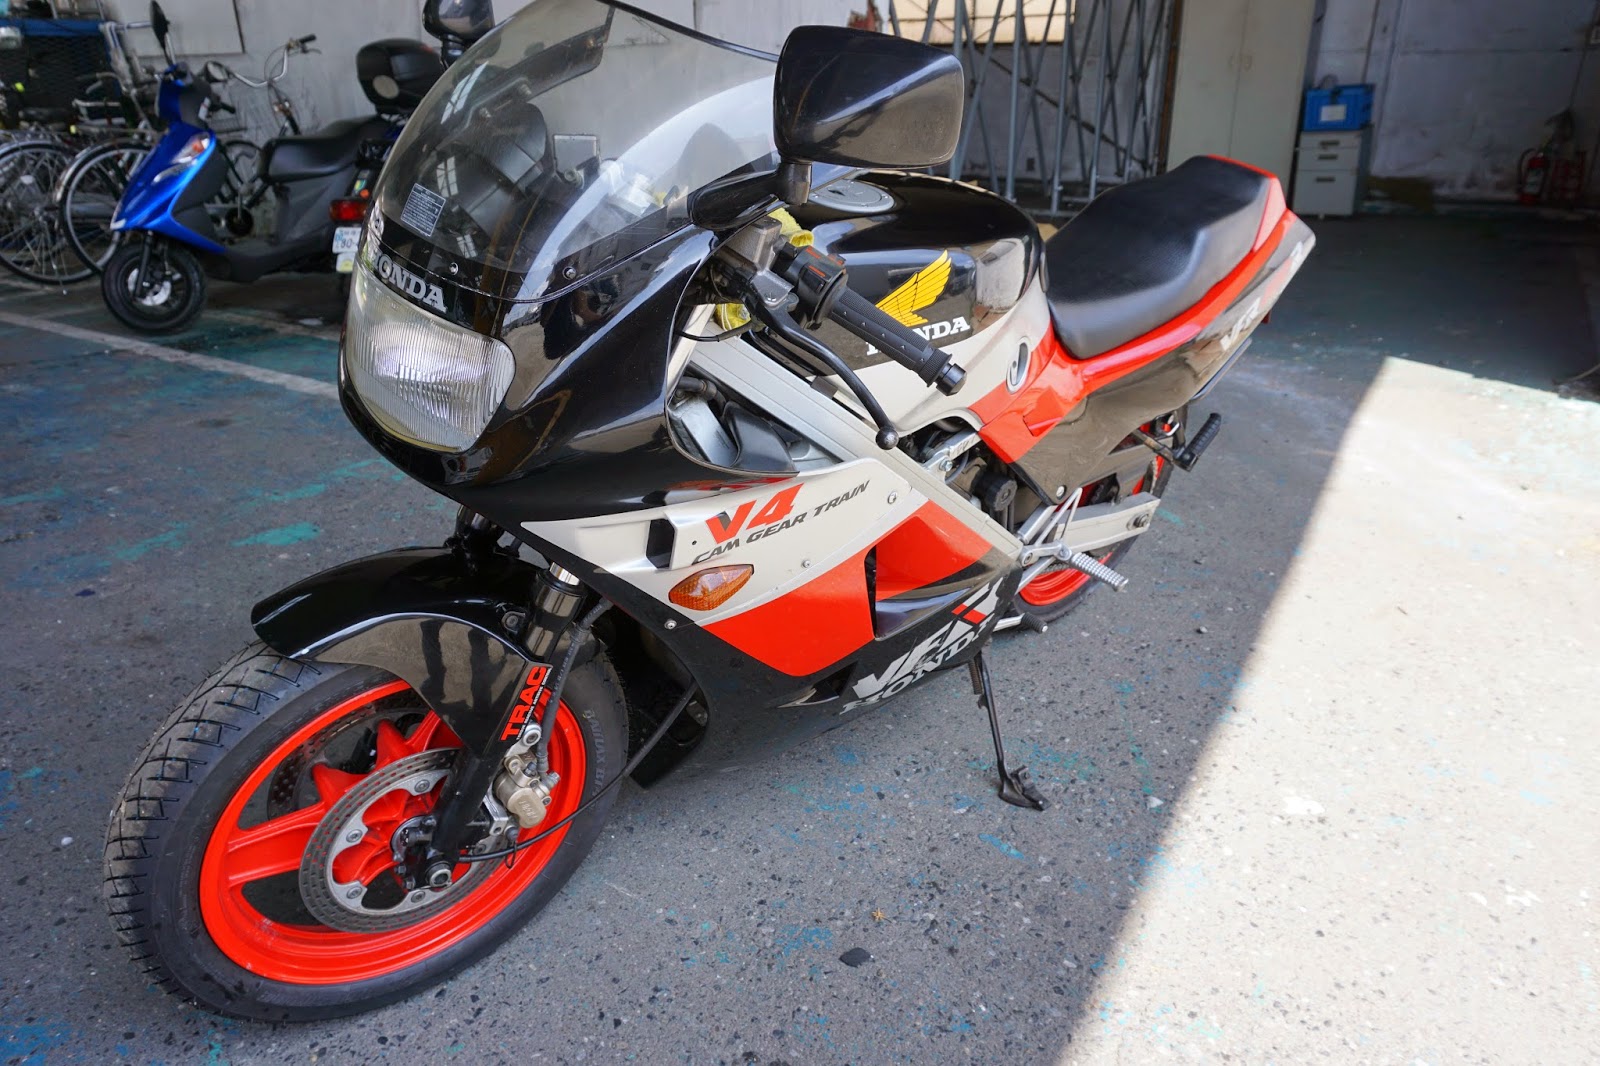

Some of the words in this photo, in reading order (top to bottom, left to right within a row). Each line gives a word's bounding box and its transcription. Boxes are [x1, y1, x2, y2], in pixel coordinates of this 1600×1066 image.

[691, 538, 740, 566] CAM
[746, 512, 807, 544] GEAR
[813, 480, 870, 517] TRAIN
[705, 482, 804, 545] V4
[500, 666, 547, 741] TRAC
